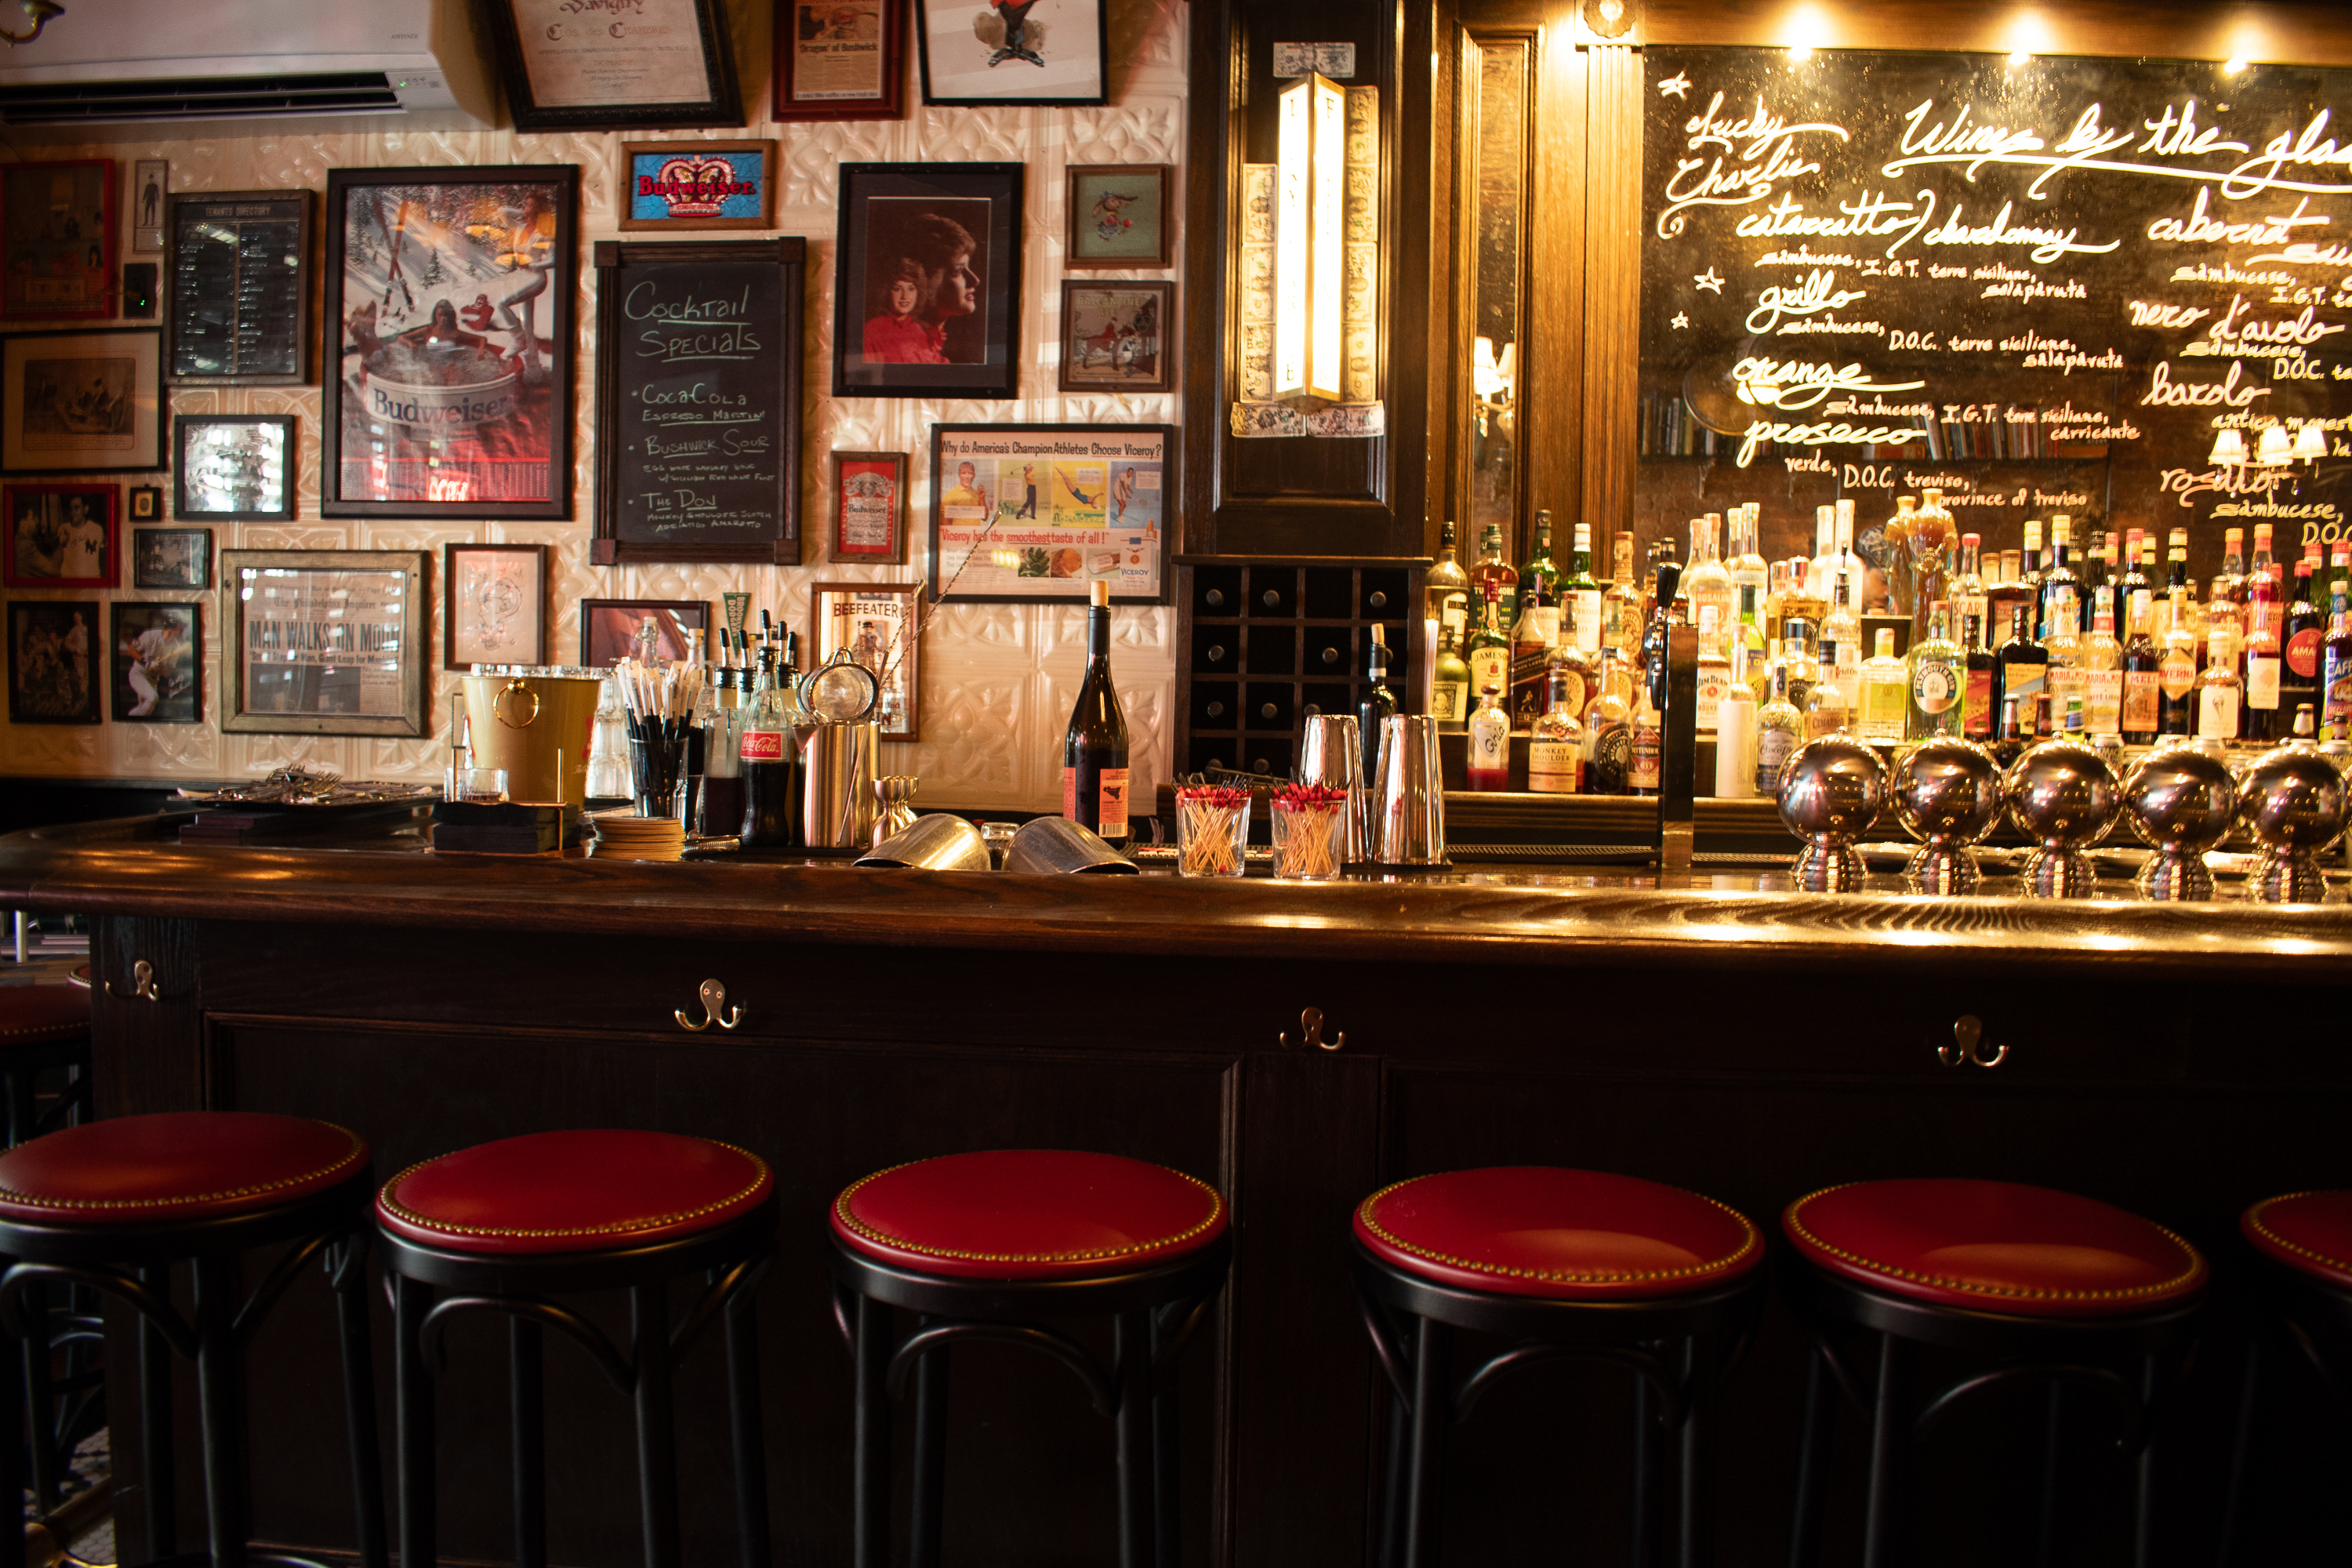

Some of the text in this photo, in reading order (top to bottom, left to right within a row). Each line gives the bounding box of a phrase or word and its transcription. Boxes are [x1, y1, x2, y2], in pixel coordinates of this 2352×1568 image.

[841, 42, 877, 52] Bushwick
[1686, 91, 1849, 161] Lucky
[1901, 99, 2044, 166] Wines
[2138, 100, 2249, 155] the
[205, 206, 270, 216] TENANTS DIRECTORY
[2148, 185, 2330, 245] cabernet
[1745, 269, 1867, 334] grillo
[1980, 278, 2087, 304] salaparuta
[2129, 299, 2210, 328] nero
[2023, 348, 2124, 376] salaparuta
[1732, 356, 1926, 410] orange
[2140, 360, 2271, 407] barolo
[373, 388, 508, 423] Budweiser
[2050, 419, 2140, 441] carricante
[942, 441, 957, 456] Why
[960, 441, 970, 452] do
[972, 441, 1010, 453] America's
[1013, 441, 1052, 456] Champion
[1054, 442, 1088, 455] Athletes
[1091, 442, 1122, 455] Choose
[1736, 419, 1928, 469] prosecco
[2011, 488, 2027, 506] of
[2034, 488, 2088, 506] treviso
[991, 530, 1004, 543] the
[1007, 531, 1050, 543] smoothest
[1051, 532, 1073, 543] taste
[1076, 532, 1086, 543] of
[728, 599, 737, 637] DODGERS
[833, 602, 899, 619] BEEFEATER
[249, 620, 281, 648] MAN
[286, 621, 331, 651] WALKS
[336, 622, 354, 652] ON
[356, 655, 365, 663] for
[1698, 677, 1710, 688] JIM
[2050, 670, 2071, 681] MARIA
[2085, 673, 2106, 684] MARIA
[2158, 669, 2194, 679] AVERNA
[742, 736, 778, 752] Coca-Cola
[1485, 725, 1505, 753] Ghia
